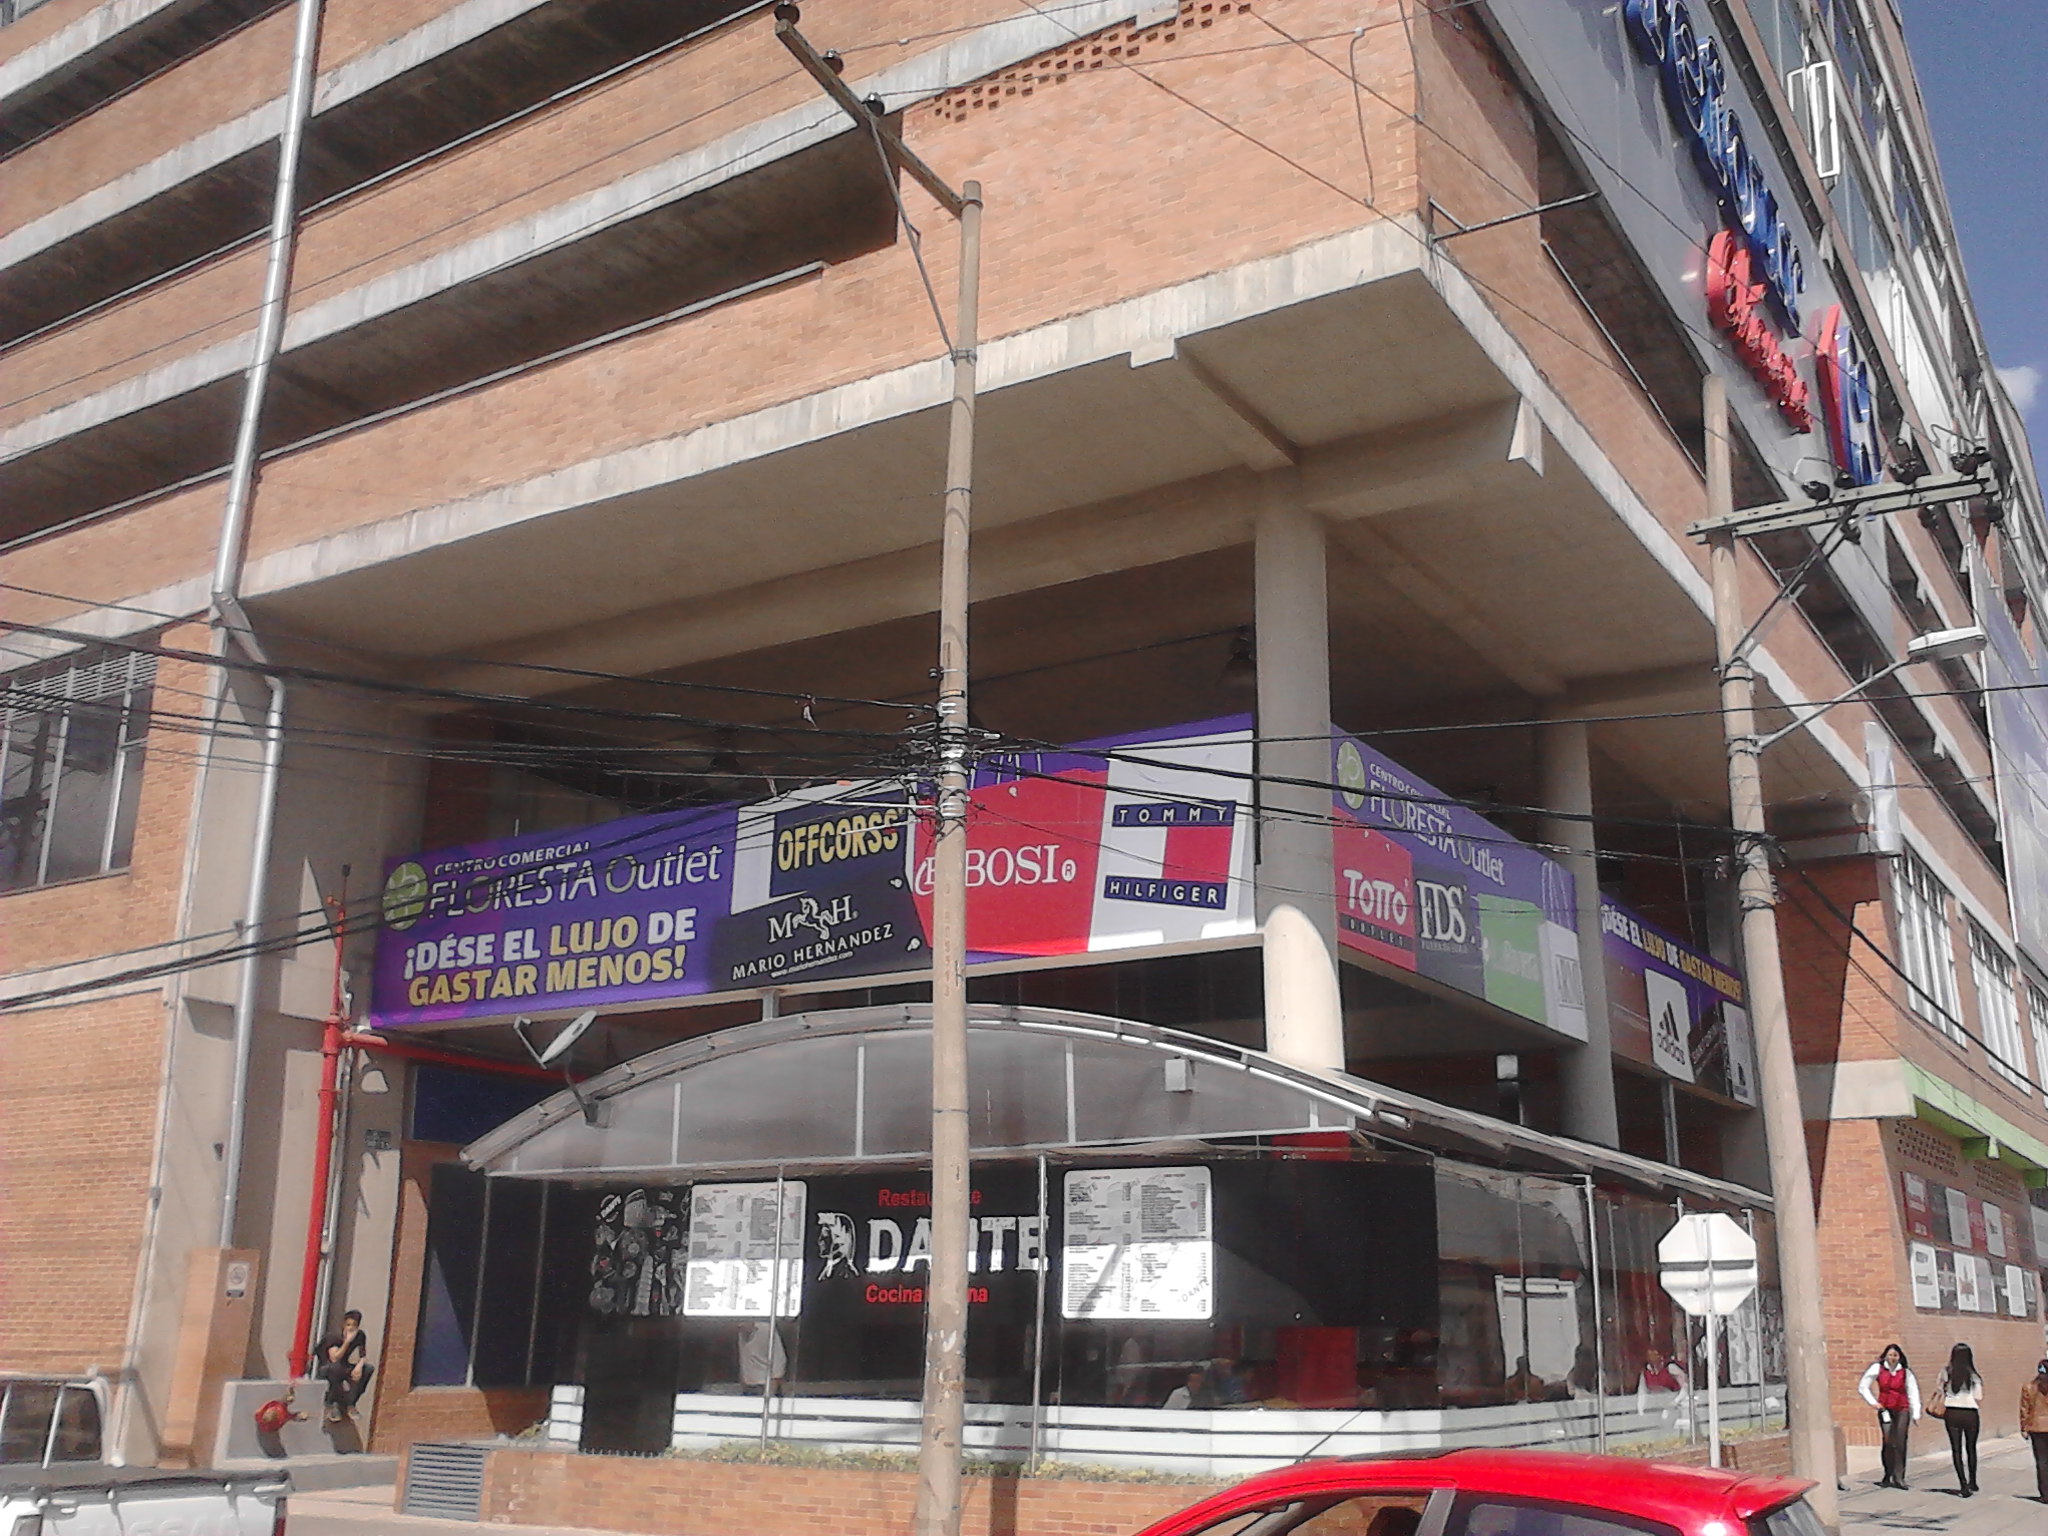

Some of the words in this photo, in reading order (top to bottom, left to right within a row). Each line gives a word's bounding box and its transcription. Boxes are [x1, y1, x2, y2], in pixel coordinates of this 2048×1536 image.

[777, 809, 898, 871] OFFCORSS
[1119, 807, 1227, 824] TOMMY
[606, 845, 723, 894] Outlet
[1109, 880, 1219, 905] HILFIGER
[1343, 869, 1407, 926] TOTTO
[404, 934, 496, 979] ¡DÉSE
[503, 927, 541, 962] EL
[549, 916, 639, 956] LUJO
[648, 907, 697, 944] DE
[733, 953, 786, 979] MARIO
[794, 924, 893, 963] HERNANDEZ
[409, 964, 538, 1006] GASTAR
[546, 944, 686, 993] MENOS!
[866, 1215, 1050, 1273] DATE
[866, 1283, 923, 1303] Cocina
